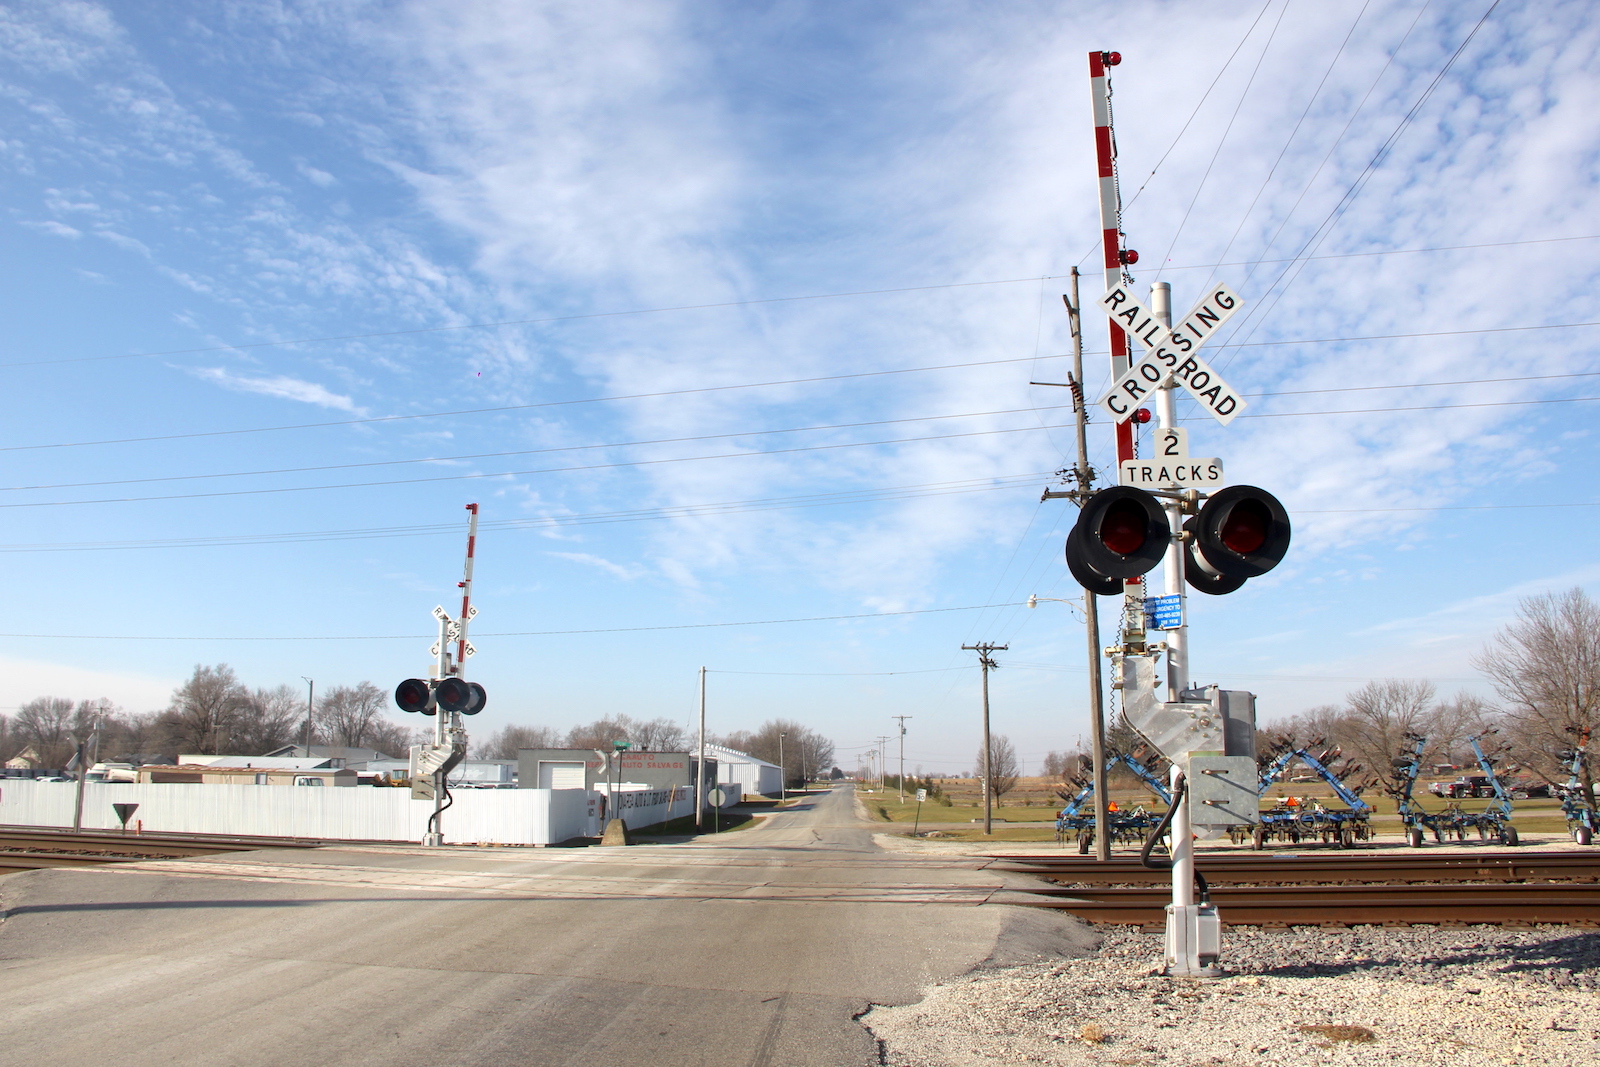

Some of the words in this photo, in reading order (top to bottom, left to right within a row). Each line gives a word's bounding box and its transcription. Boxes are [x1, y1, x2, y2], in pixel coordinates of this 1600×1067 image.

[1104, 288, 1159, 348] RAIL
[1176, 357, 1237, 416] ROAD
[1107, 290, 1235, 415] CROSSING
[1127, 465, 1218, 482] TRACKS
[1164, 435, 1179, 456] 2
